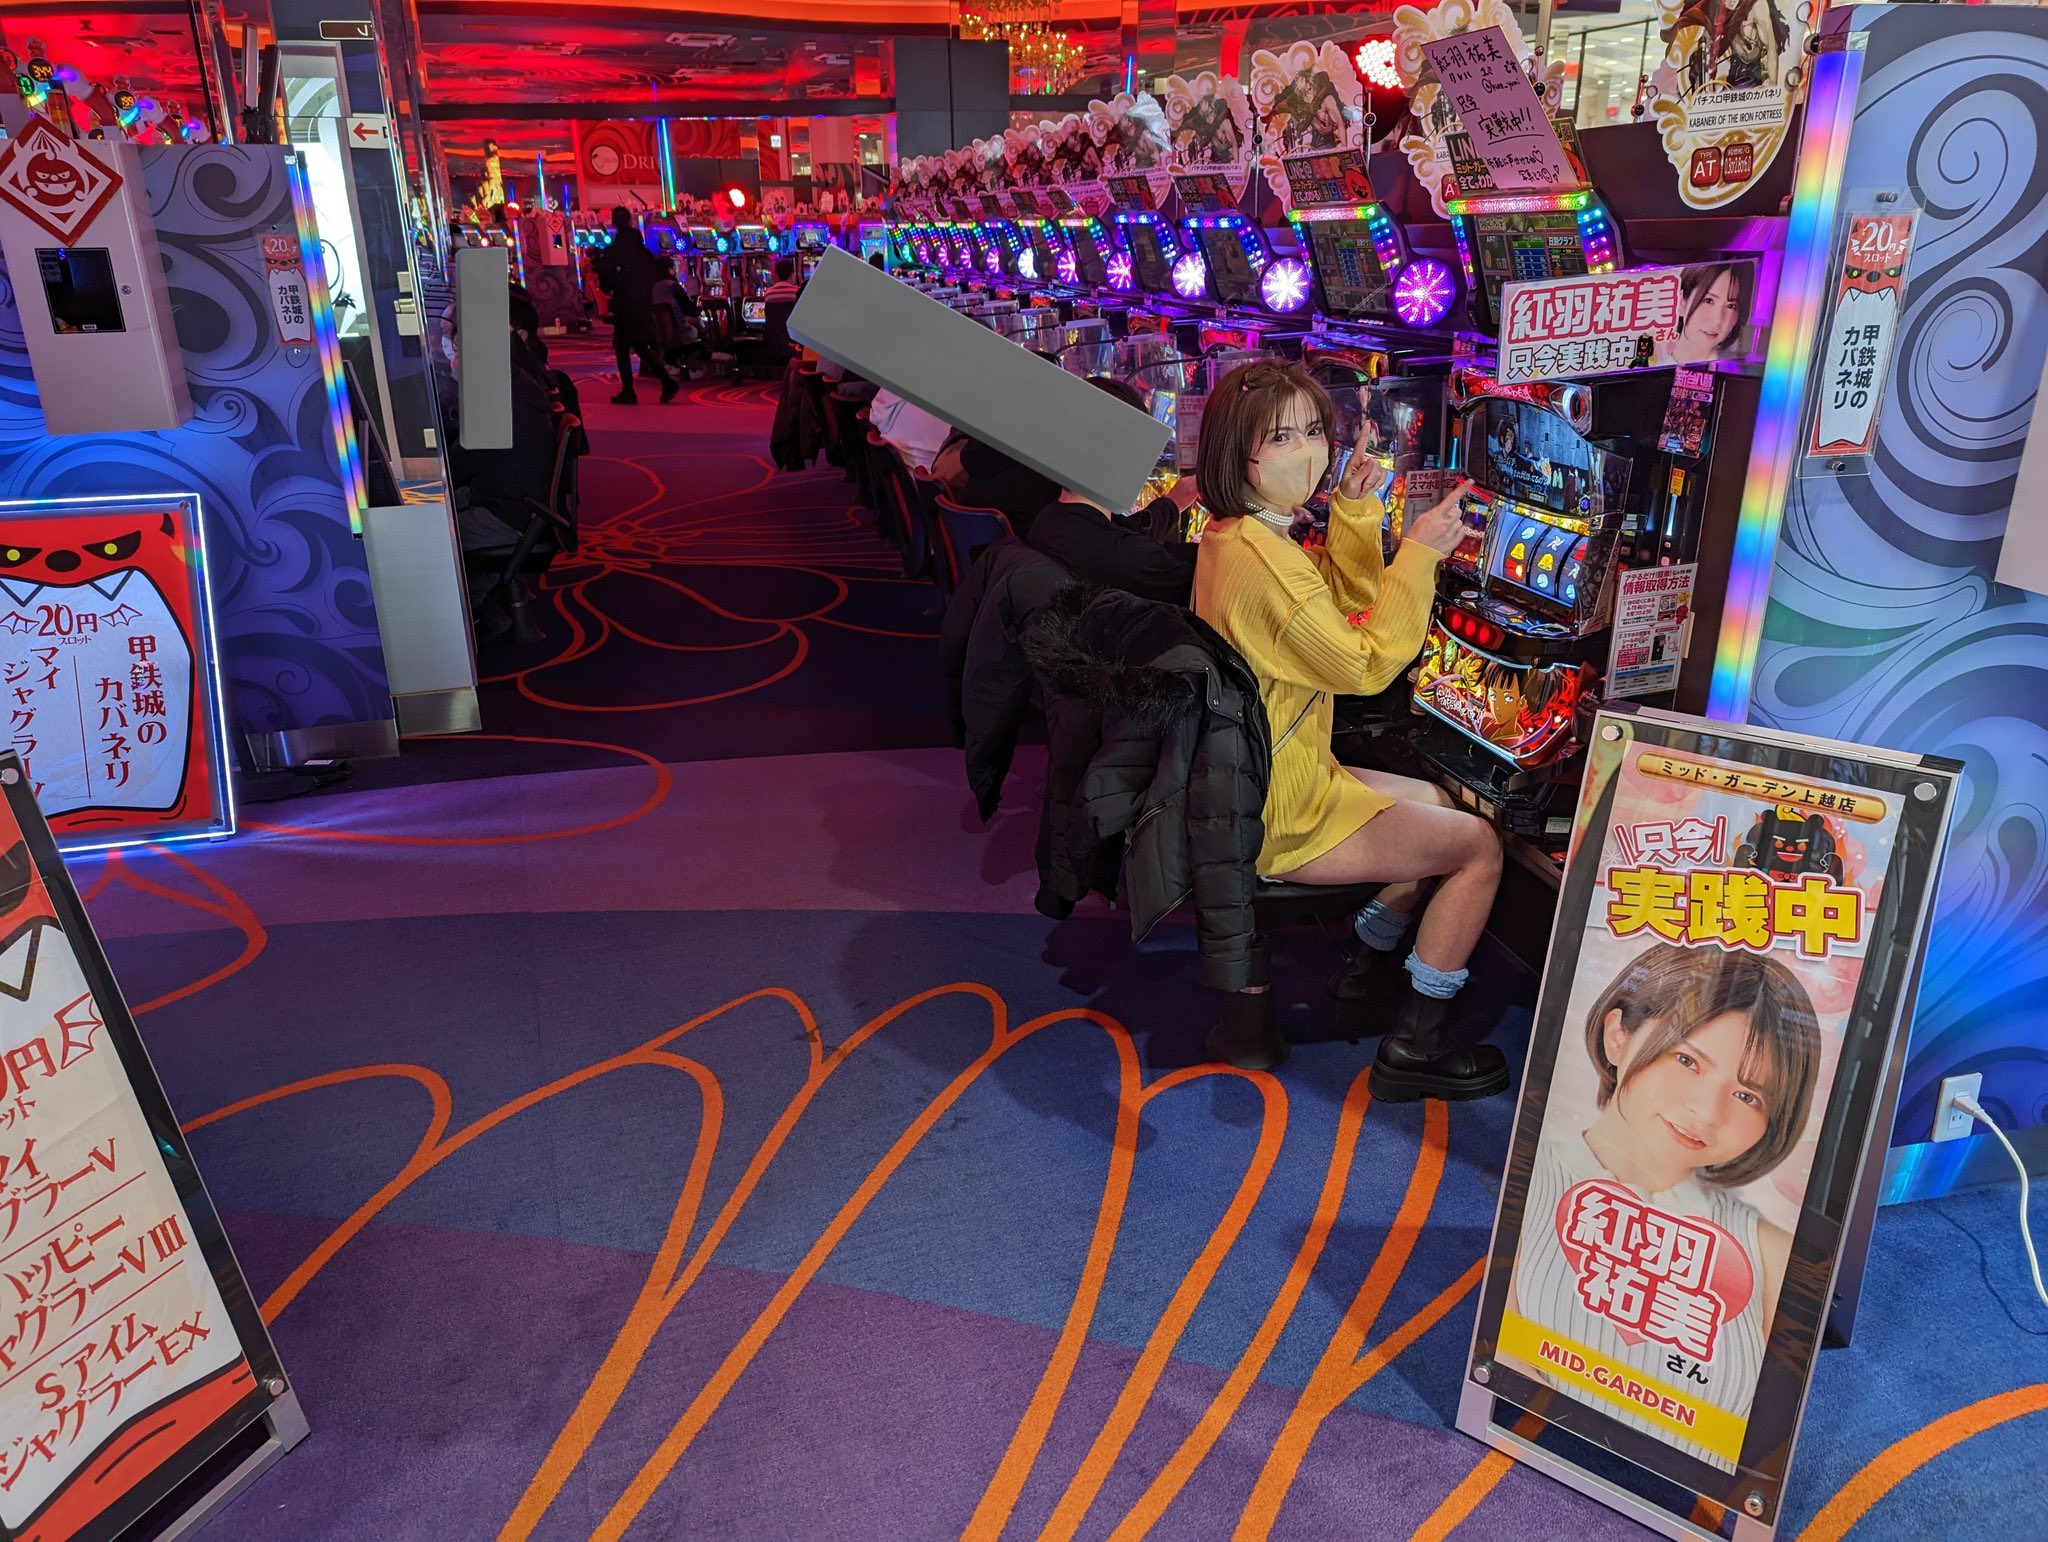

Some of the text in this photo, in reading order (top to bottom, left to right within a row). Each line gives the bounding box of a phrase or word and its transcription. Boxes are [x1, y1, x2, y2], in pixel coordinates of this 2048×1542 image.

[32, 65, 52, 78] 344
[1432, 35, 1503, 74] 紅羽祐美
[1689, 109, 1782, 128] KABANERI OF THE IRON FORTRESS
[1693, 88, 1782, 106] パチスロ甲鉄城のカバネリ
[1693, 159, 1716, 179] AT
[1861, 221, 1896, 252] 20円
[1863, 253, 1892, 263] スロット
[278, 286, 292, 324] カバネリ
[288, 285, 304, 324] 甲鉄城の
[1510, 277, 1678, 342] 紅羽祐美
[1655, 326, 1679, 341] さん
[1507, 337, 1636, 381] 只今実践中
[1834, 326, 1861, 410] カバネリ
[1850, 324, 1880, 410] 甲鉄城の
[1623, 575, 1690, 595] 情報取得方法
[36, 604, 98, 636] 20円
[58, 635, 92, 646] スロット
[30, 646, 61, 690] マイ
[128, 634, 167, 745] 甲鉄城の
[95, 677, 131, 788] カバネリ
[1661, 760, 1857, 814] ミッド・ガーデン上越店
[1634, 819, 1713, 866] 只今
[1608, 867, 1862, 956] 実践中
[0, 1037, 57, 1100] 円
[1570, 1187, 1711, 1292] 紅羽
[1582, 1258, 1719, 1360] 祐美
[35, 1313, 158, 1412] Sアイム
[1539, 1340, 1697, 1427] MID.GARDEN
[1666, 1353, 1710, 1385] さん
[0, 1311, 211, 1491] ジャグラーEX
